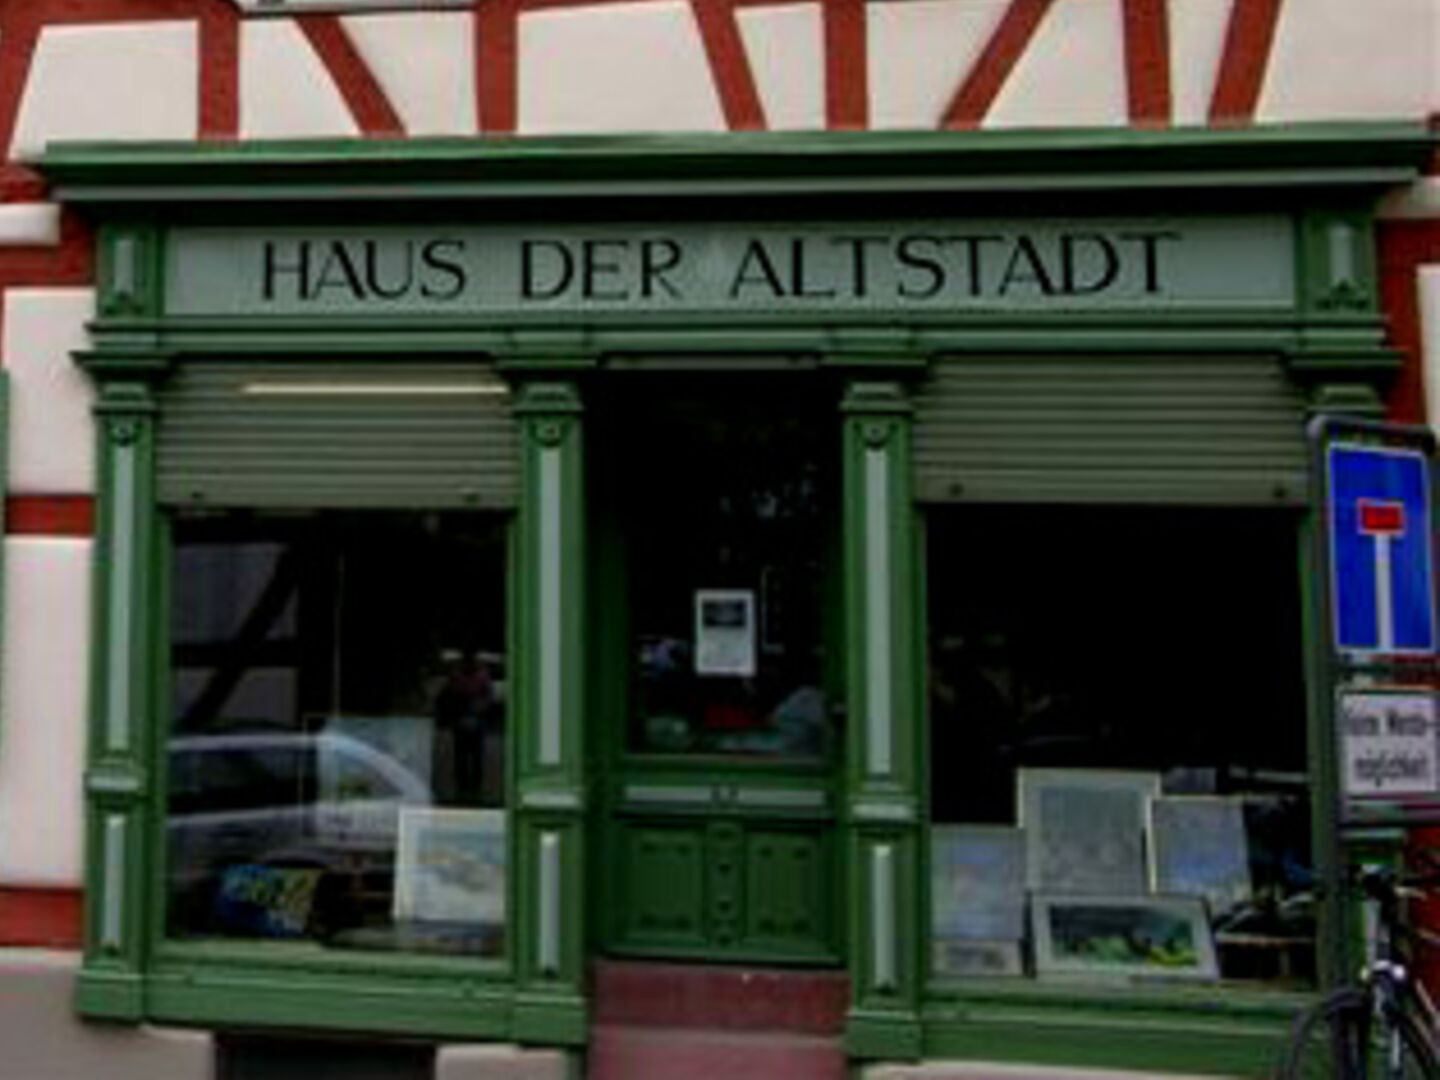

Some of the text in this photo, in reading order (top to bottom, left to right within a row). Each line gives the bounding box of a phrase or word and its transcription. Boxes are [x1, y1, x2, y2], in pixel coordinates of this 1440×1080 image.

[263, 231, 1181, 301] HAUS DER ALTSTADT
